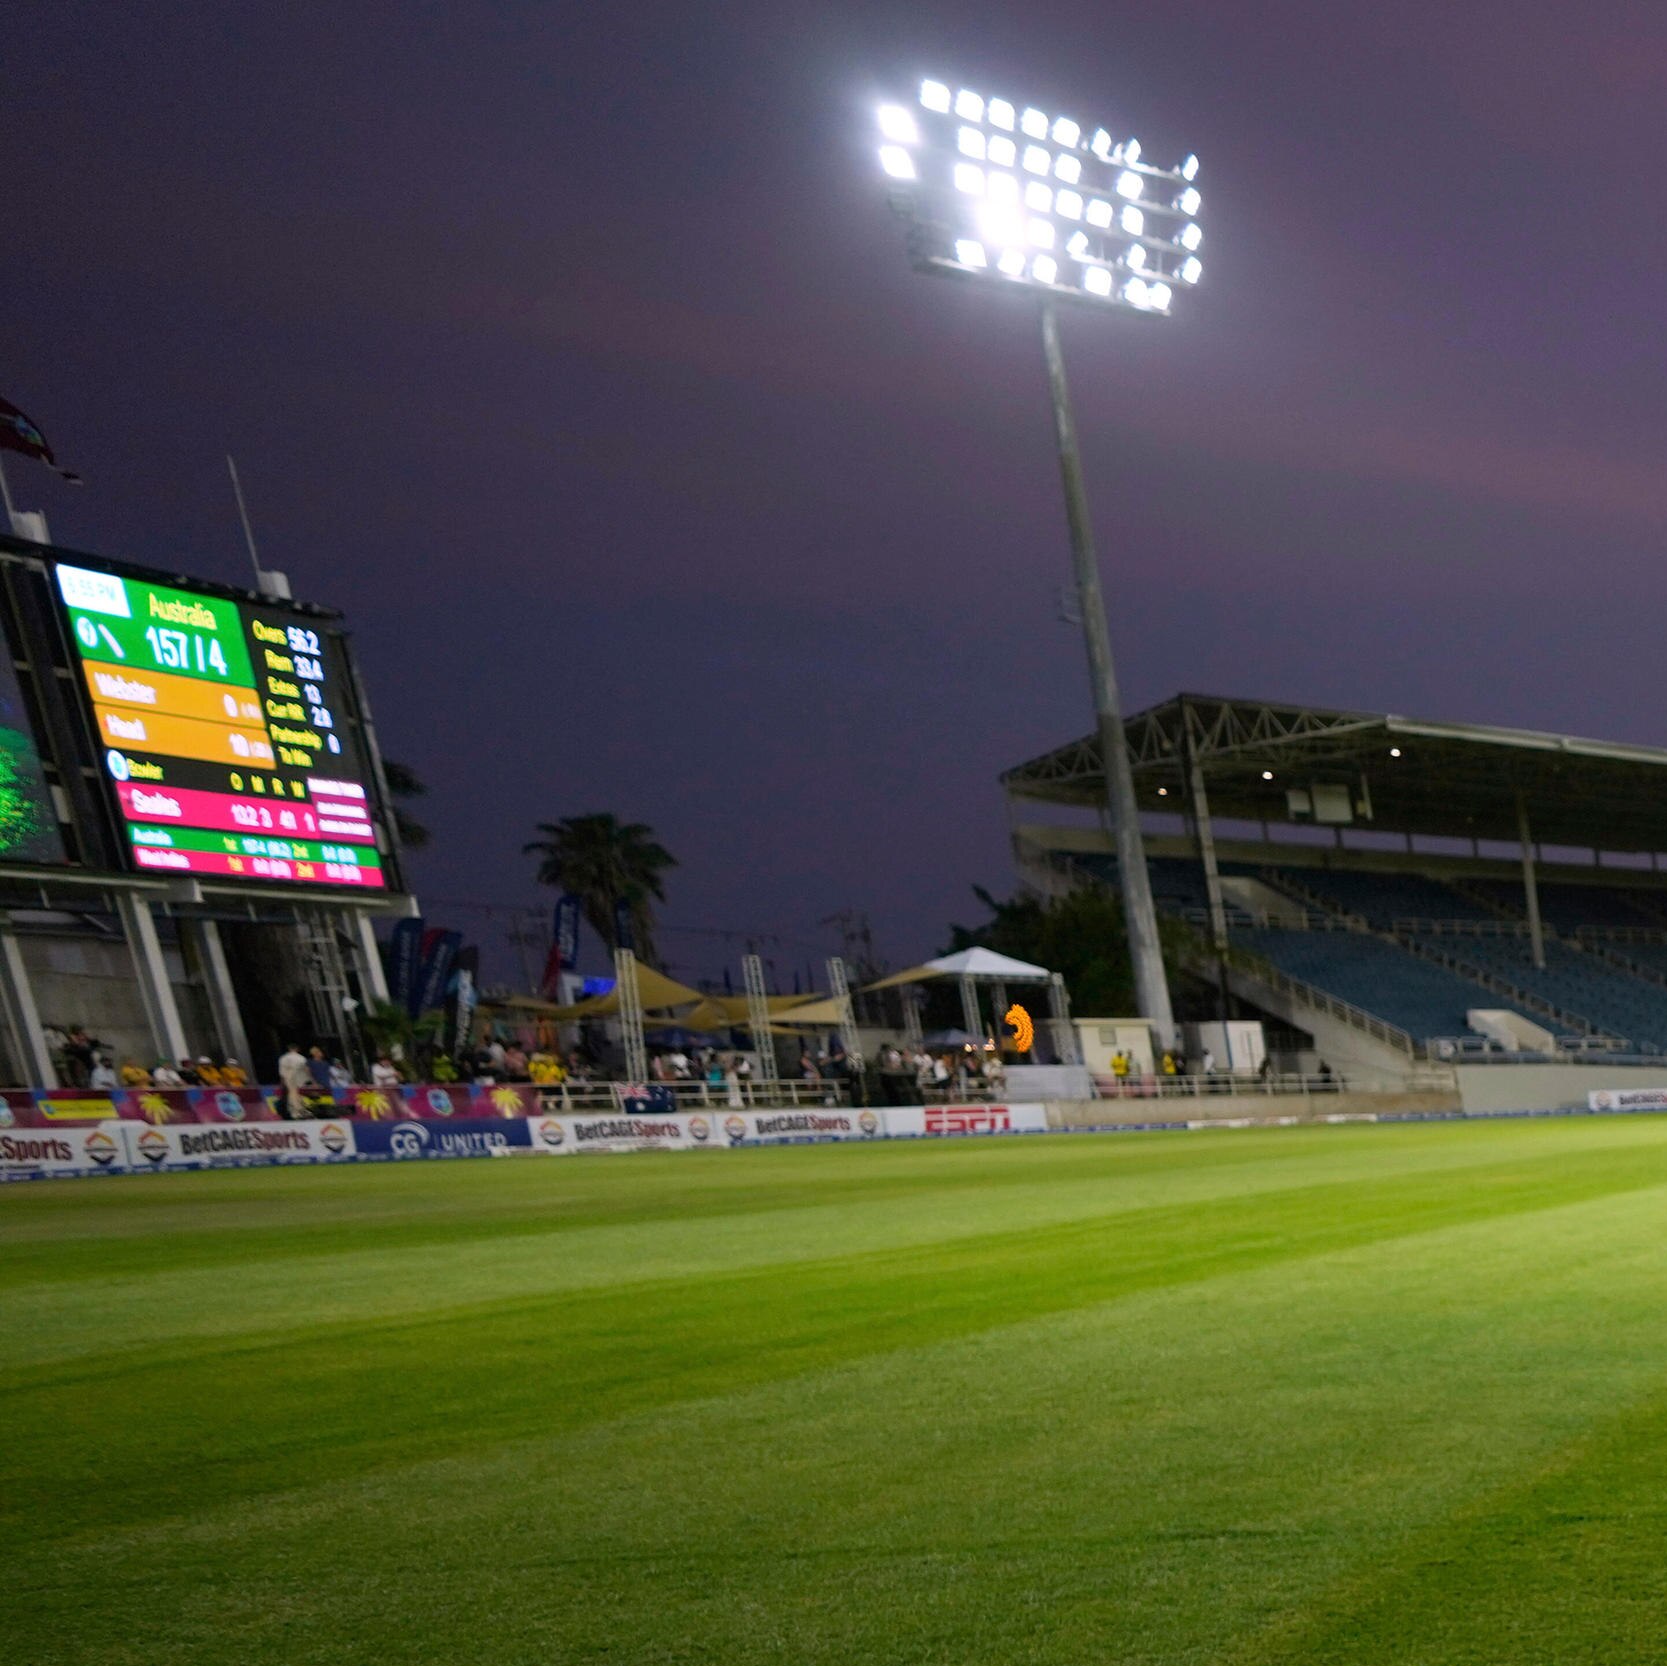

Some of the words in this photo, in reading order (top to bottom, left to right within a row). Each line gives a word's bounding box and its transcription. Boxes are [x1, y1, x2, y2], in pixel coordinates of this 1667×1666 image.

[149, 592, 217, 630] Australia
[925, 1105, 1011, 1134] ESPN
[0, 1136, 72, 1163] Sports
[180, 1128, 311, 1155] BetCAGESports
[441, 1132, 508, 1149] UNITED
